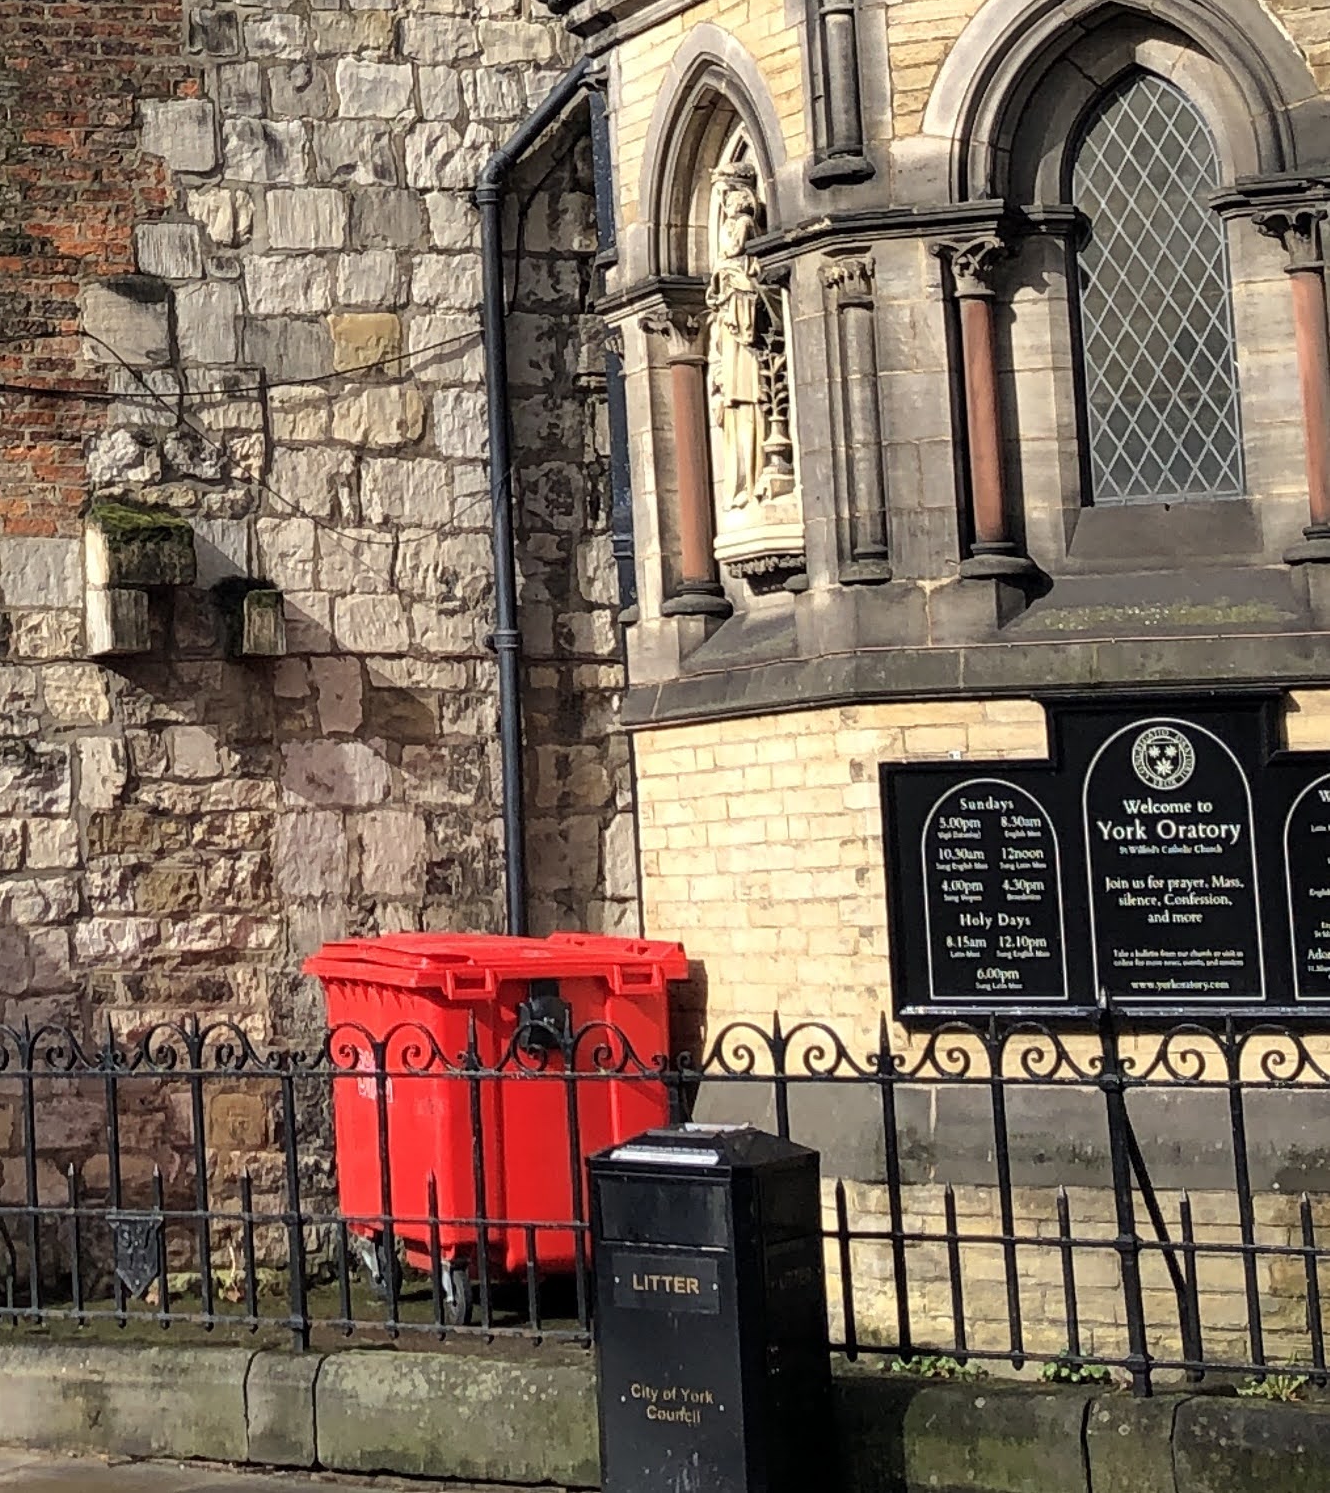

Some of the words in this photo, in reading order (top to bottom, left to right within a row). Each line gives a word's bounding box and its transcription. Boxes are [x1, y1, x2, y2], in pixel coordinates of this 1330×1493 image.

[959, 795, 1014, 813] Sundays
[1123, 797, 1192, 815] Welcome
[1197, 800, 1213, 813] to
[939, 816, 981, 832] 5.00pm
[1000, 815, 1041, 828] 8.30am
[1096, 818, 1148, 841] York
[1156, 819, 1241, 845] Oratory
[938, 847, 985, 860] 10.30am
[1001, 847, 1044, 860] 12noon
[941, 879, 984, 895] 4.00pm
[1001, 878, 1045, 894] 4.30pm
[1105, 876, 1129, 893] Join
[1132, 879, 1145, 889] us
[1147, 874, 1164, 889] for
[1118, 892, 1162, 907] silence,
[959, 911, 992, 930] Holy
[998, 912, 1031, 930] Days
[1148, 909, 1170, 923] and
[1172, 912, 1203, 924] more
[946, 935, 987, 948] 8.15am
[999, 935, 1047, 953] 12.10pm
[976, 967, 1020, 984] 6.00pm
[1130, 978, 1230, 991] www.yorkoratory.com
[632, 1272, 700, 1295] LITTER
[631, 1382, 659, 1403] City
[663, 1386, 676, 1401] of
[680, 1387, 715, 1405] York
[646, 1405, 701, 1424] Council
